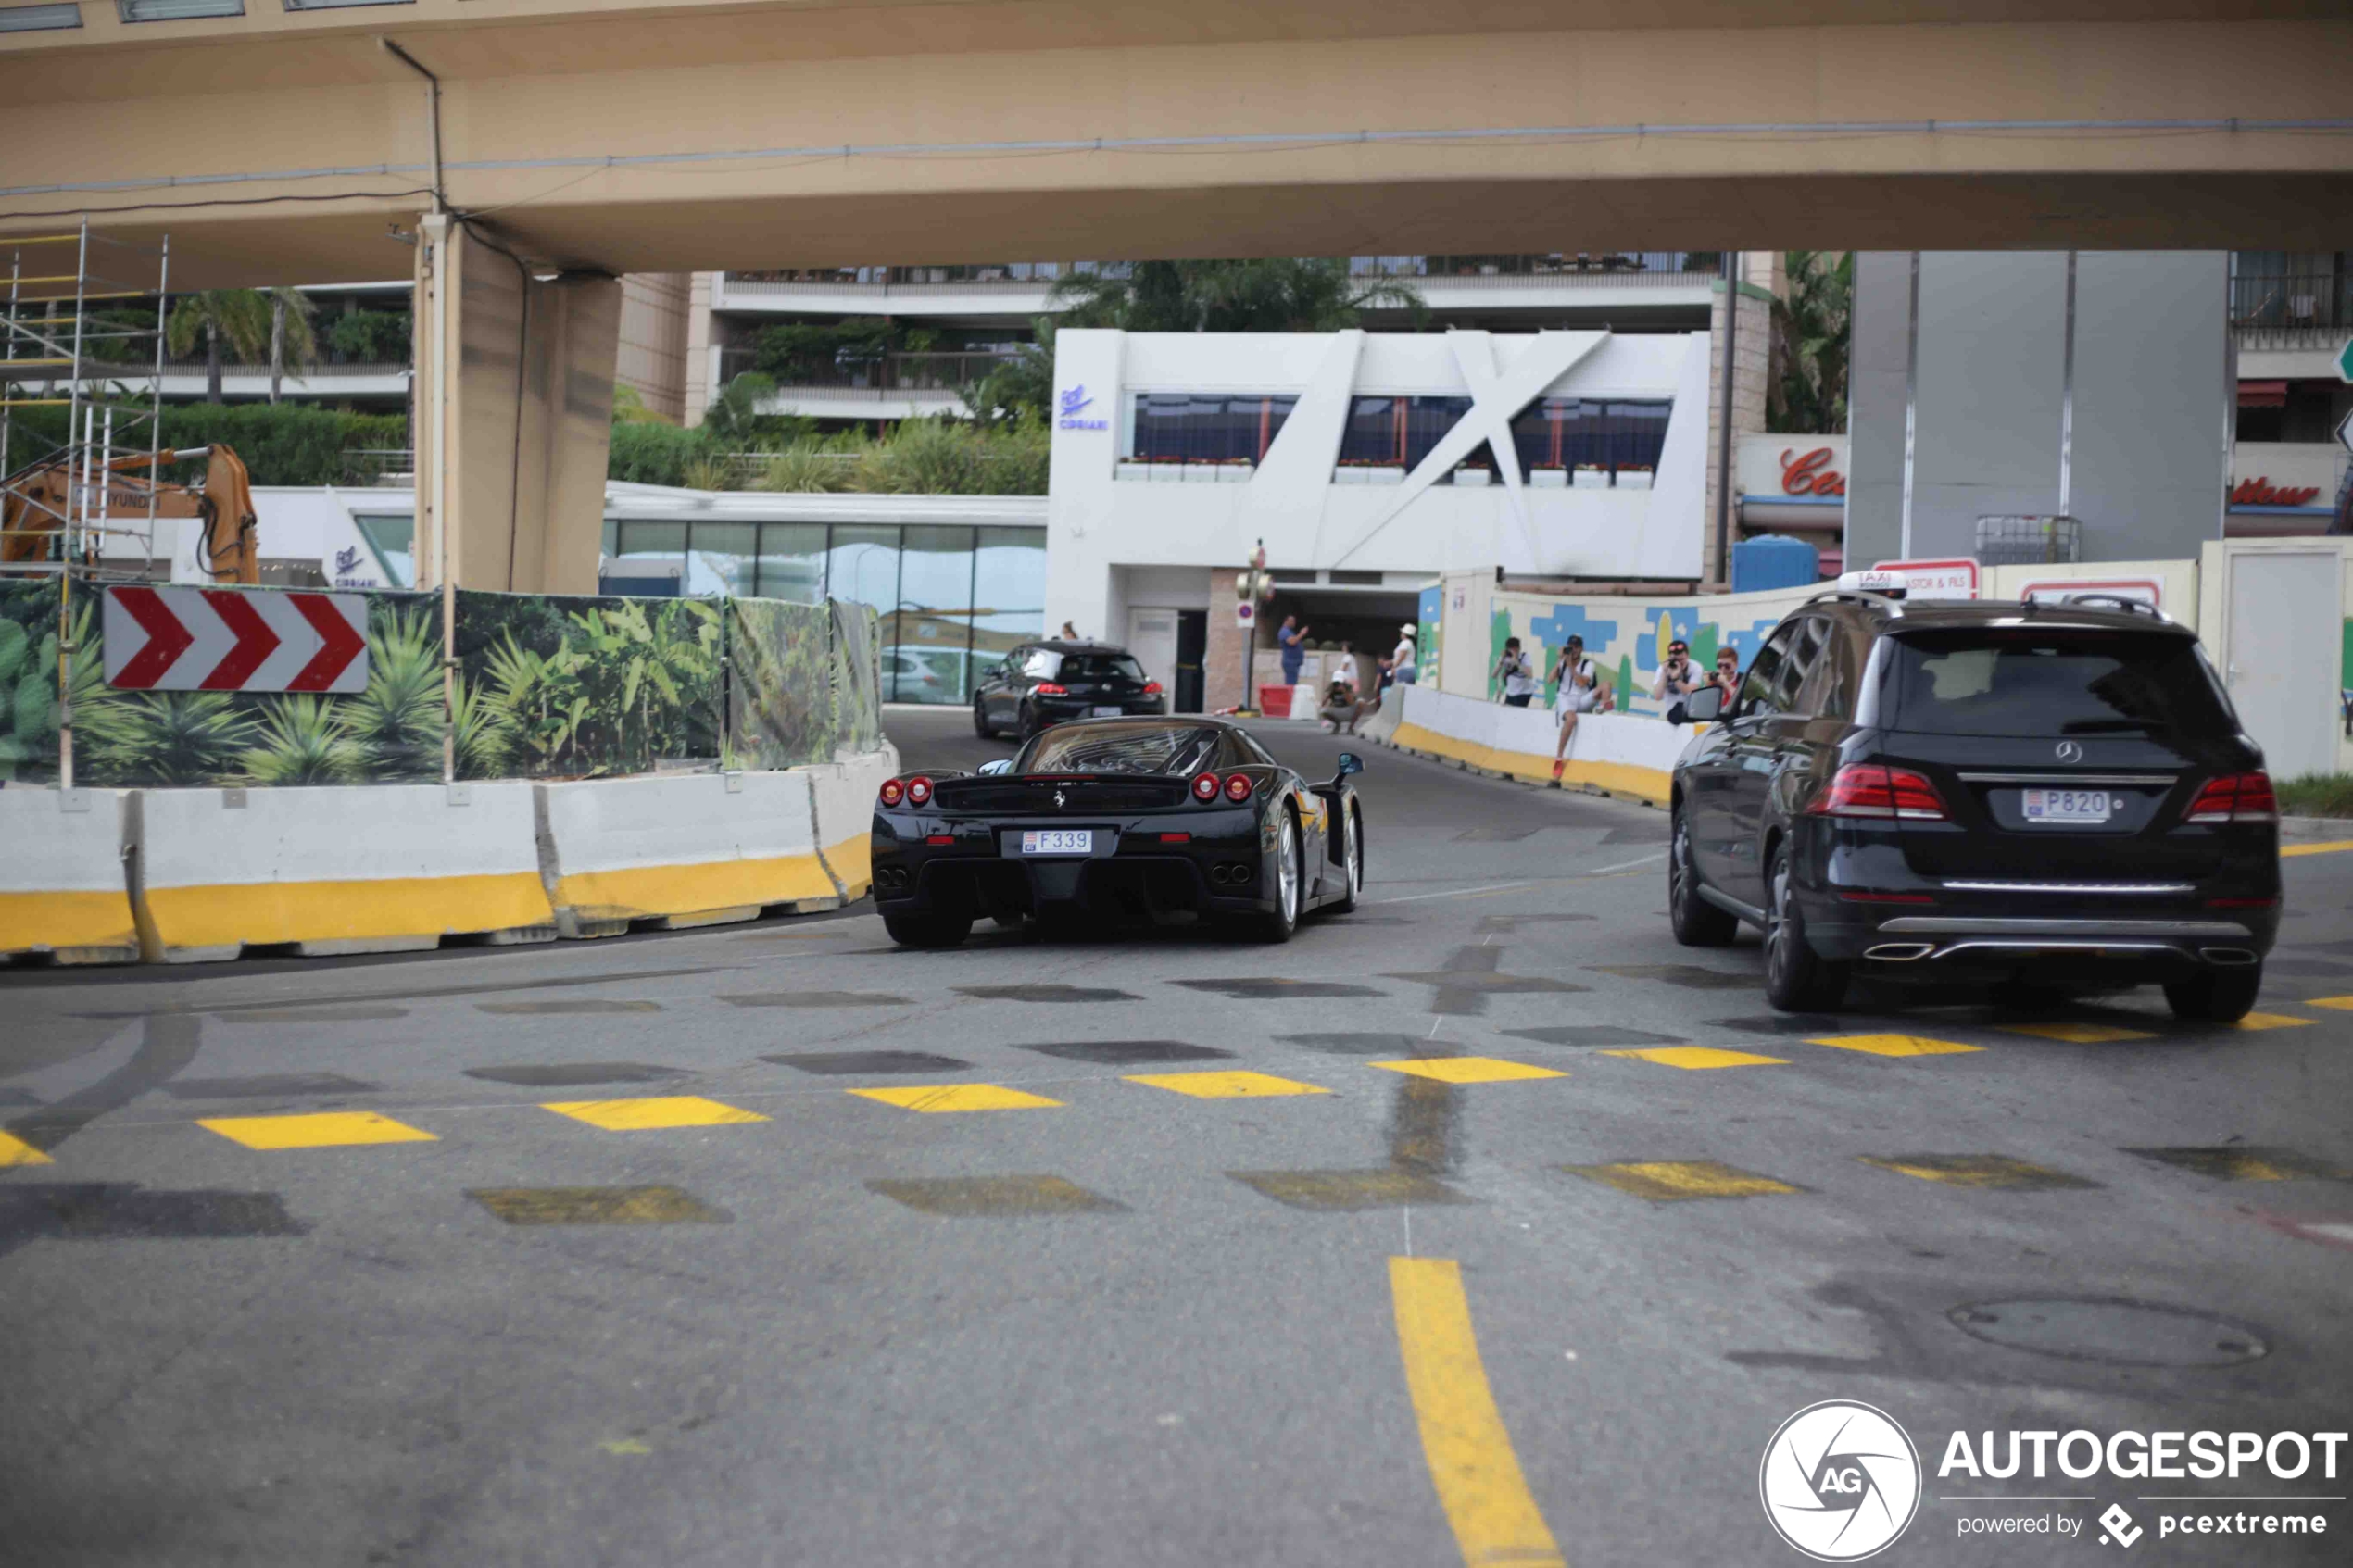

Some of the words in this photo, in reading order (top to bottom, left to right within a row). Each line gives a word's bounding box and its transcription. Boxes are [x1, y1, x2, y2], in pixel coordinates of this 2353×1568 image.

[1858, 572, 1892, 582] TAXI
[2048, 792, 2106, 812] P820
[1040, 832, 1087, 848] F339
